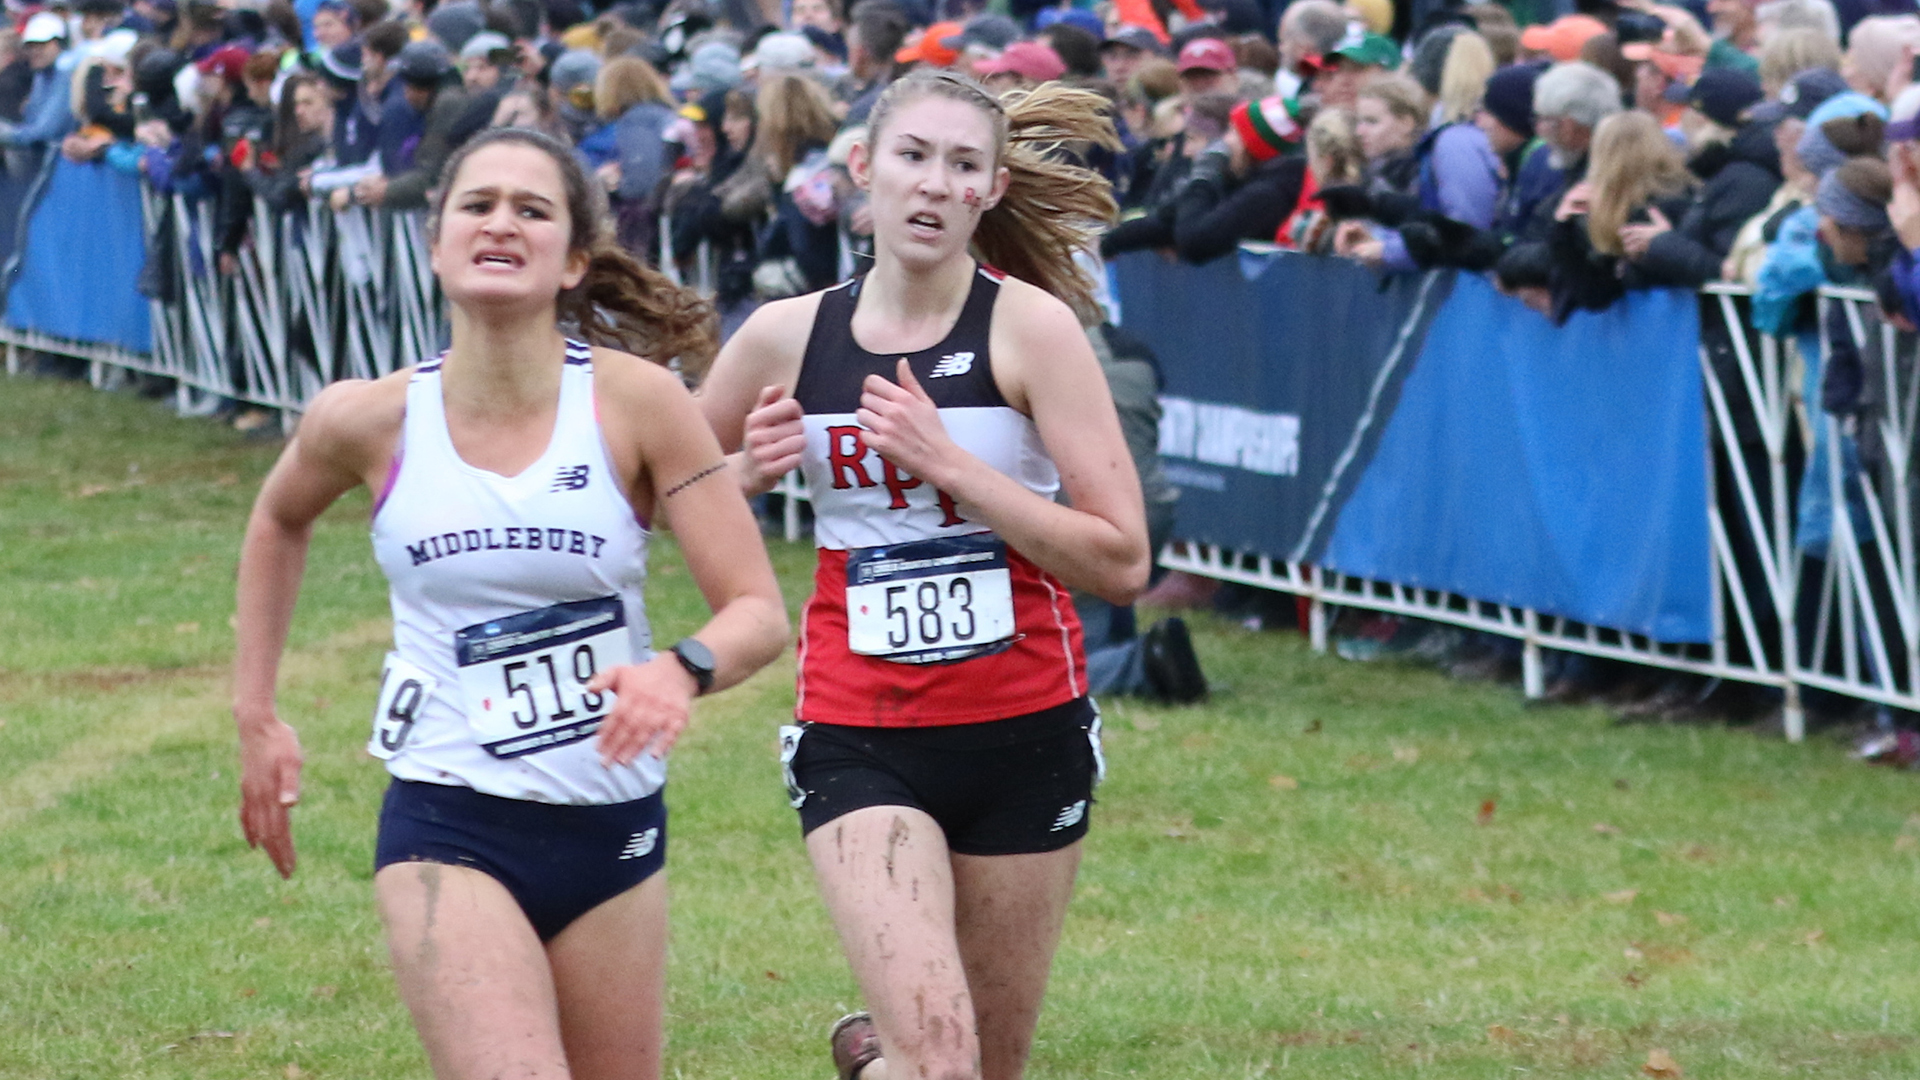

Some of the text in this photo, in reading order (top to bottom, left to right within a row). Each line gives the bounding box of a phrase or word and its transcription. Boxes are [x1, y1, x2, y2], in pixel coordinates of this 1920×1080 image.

[405, 527, 607, 567] MIDDLEBURY
[886, 576, 976, 649] 583
[502, 643, 604, 730] 519
